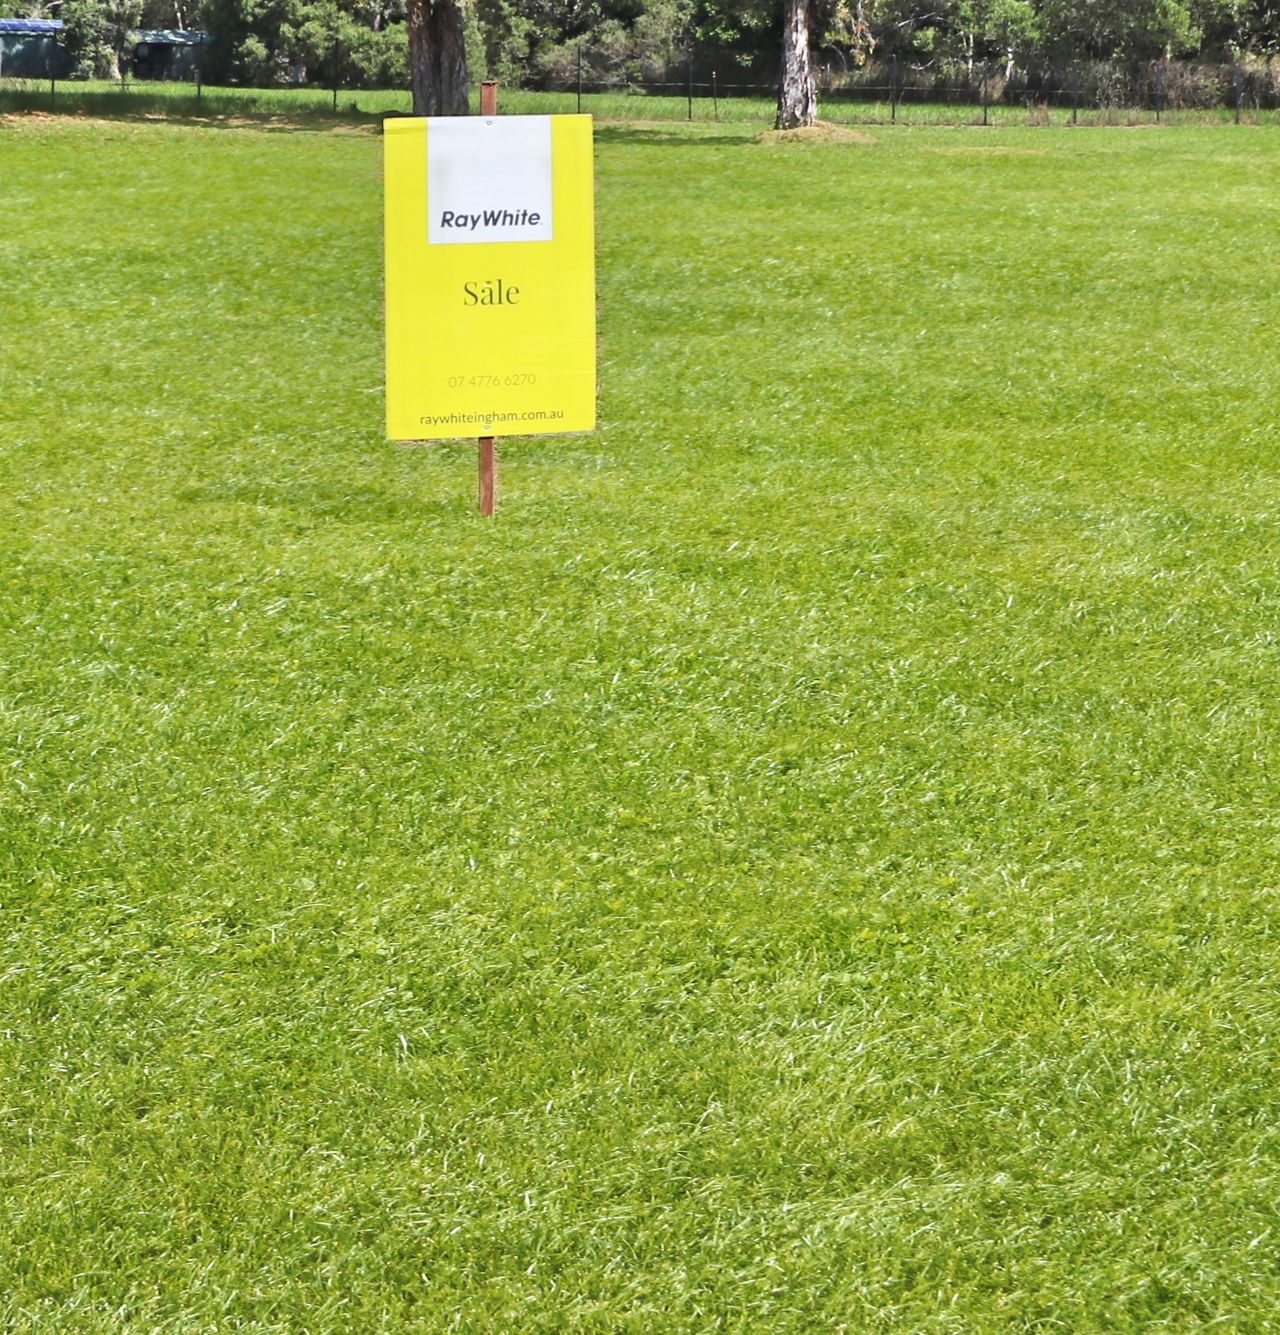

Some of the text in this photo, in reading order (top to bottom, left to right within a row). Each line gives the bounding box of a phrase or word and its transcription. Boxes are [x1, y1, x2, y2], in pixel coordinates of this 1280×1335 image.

[463, 278, 520, 306] Sale
[448, 373, 536, 388] 07 4776 6270
[420, 410, 564, 426] raywhiteingham.com.au
